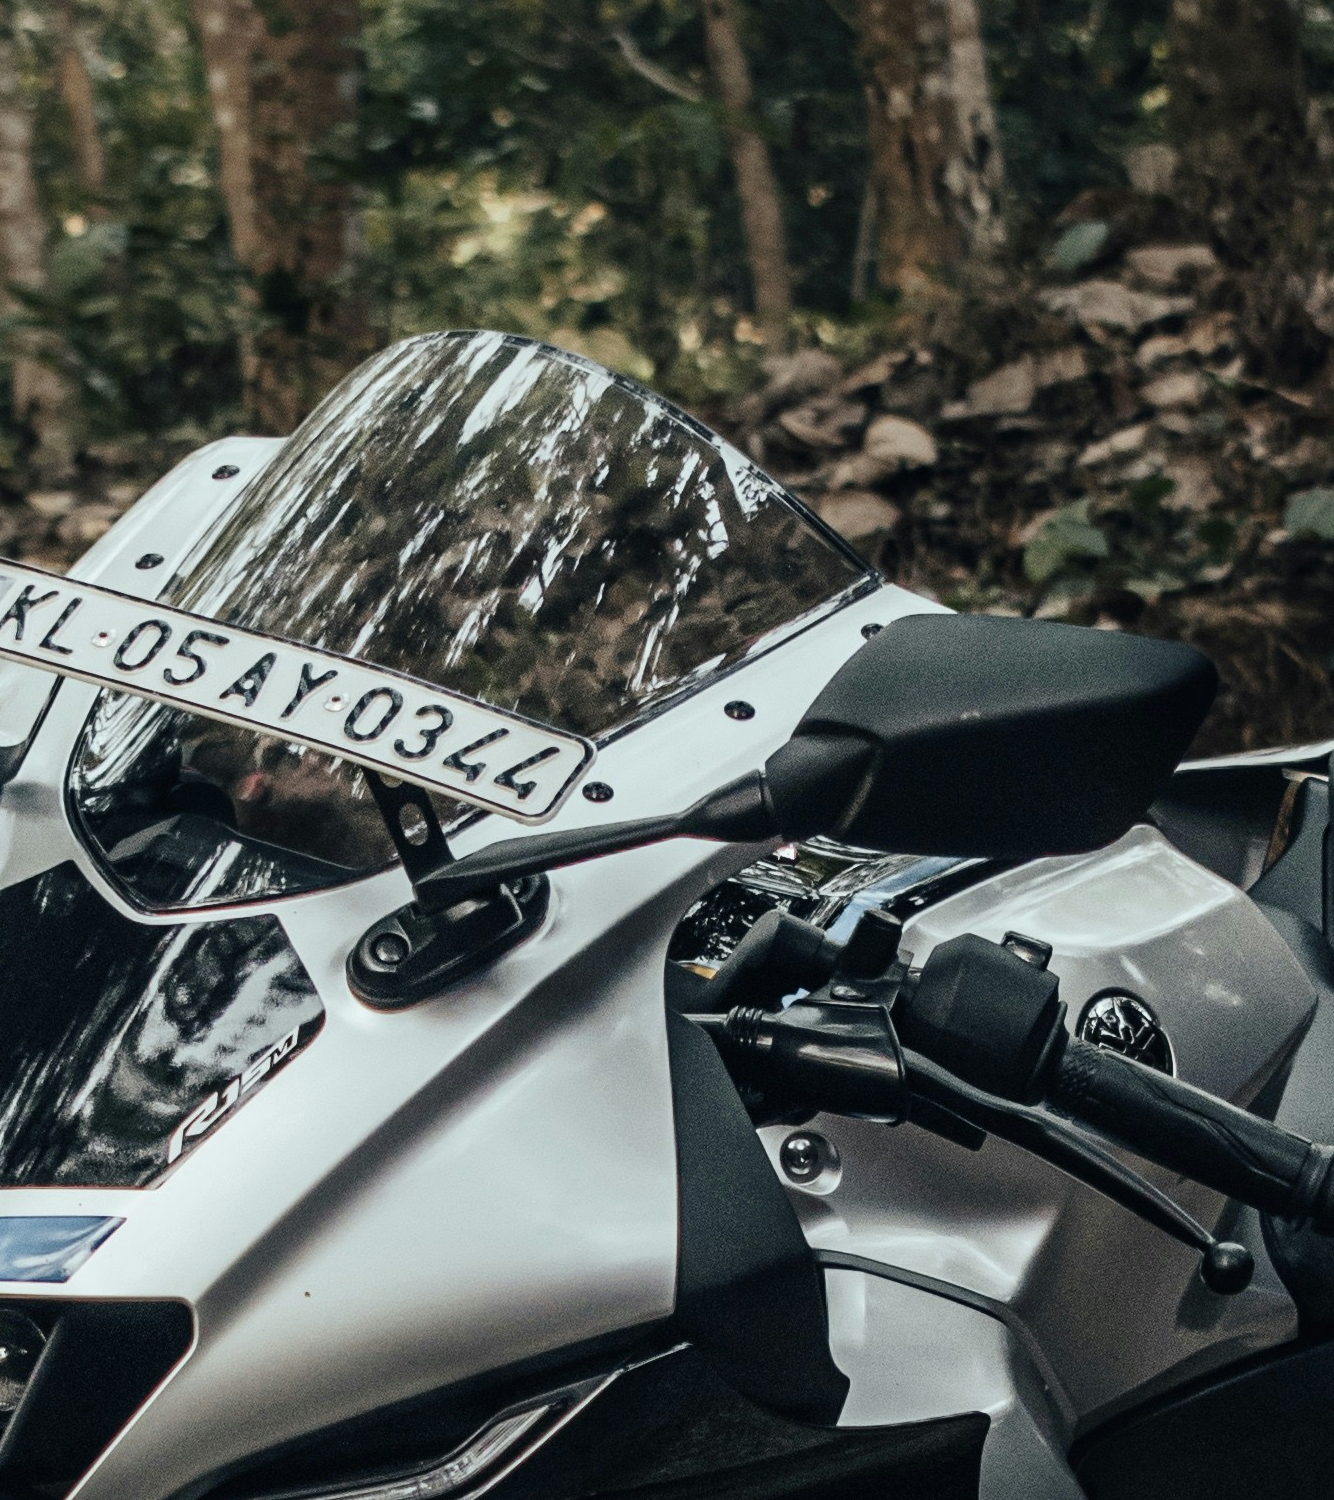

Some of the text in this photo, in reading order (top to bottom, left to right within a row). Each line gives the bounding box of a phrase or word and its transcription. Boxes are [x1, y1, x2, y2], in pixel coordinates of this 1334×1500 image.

[112, 619, 229, 687] 05
[219, 650, 338, 721] AY
[343, 685, 561, 800] 0344
[167, 1025, 300, 1164] R15M
